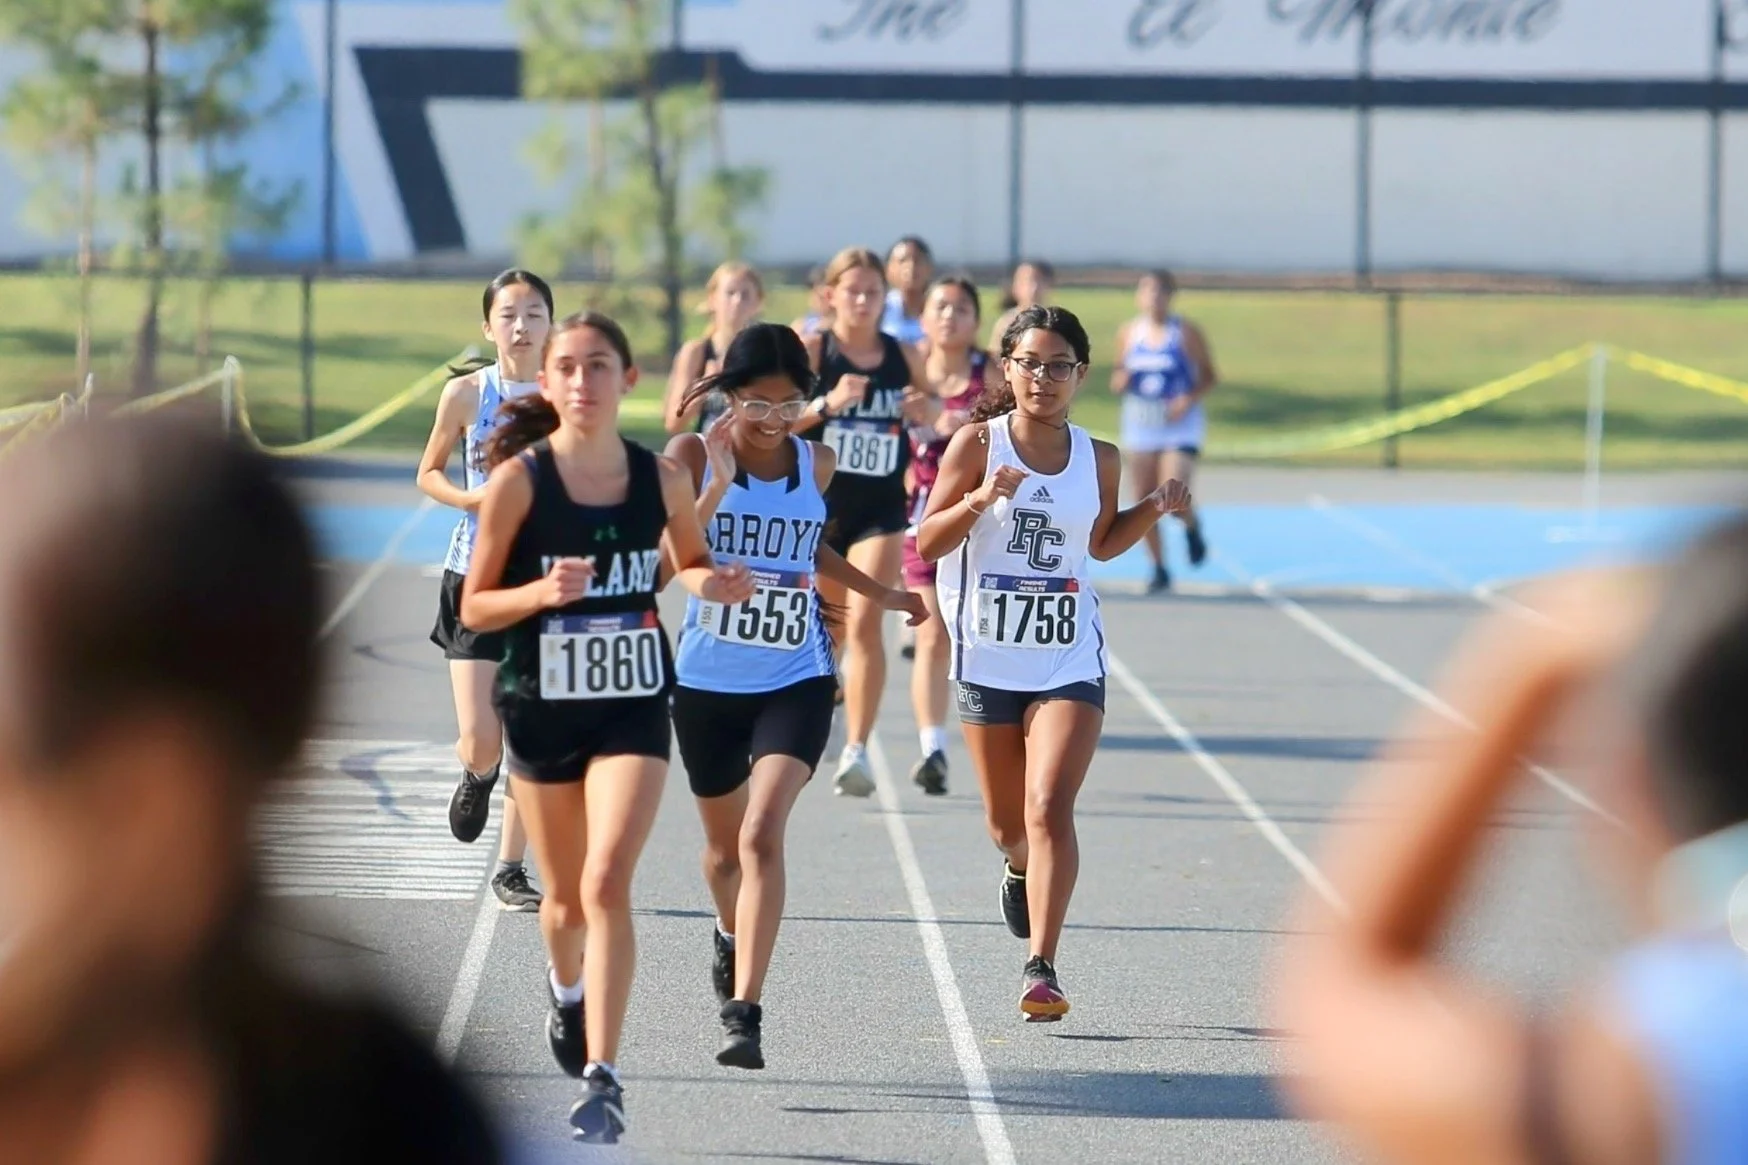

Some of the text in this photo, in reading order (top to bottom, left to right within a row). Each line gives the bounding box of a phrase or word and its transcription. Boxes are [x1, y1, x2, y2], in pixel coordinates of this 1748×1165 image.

[837, 433, 893, 472] 1861
[1029, 496, 1054, 504] adidas
[540, 549, 660, 598] LAND
[718, 588, 808, 646] 1553
[994, 593, 1076, 645] 1758
[560, 632, 659, 692] 1860
